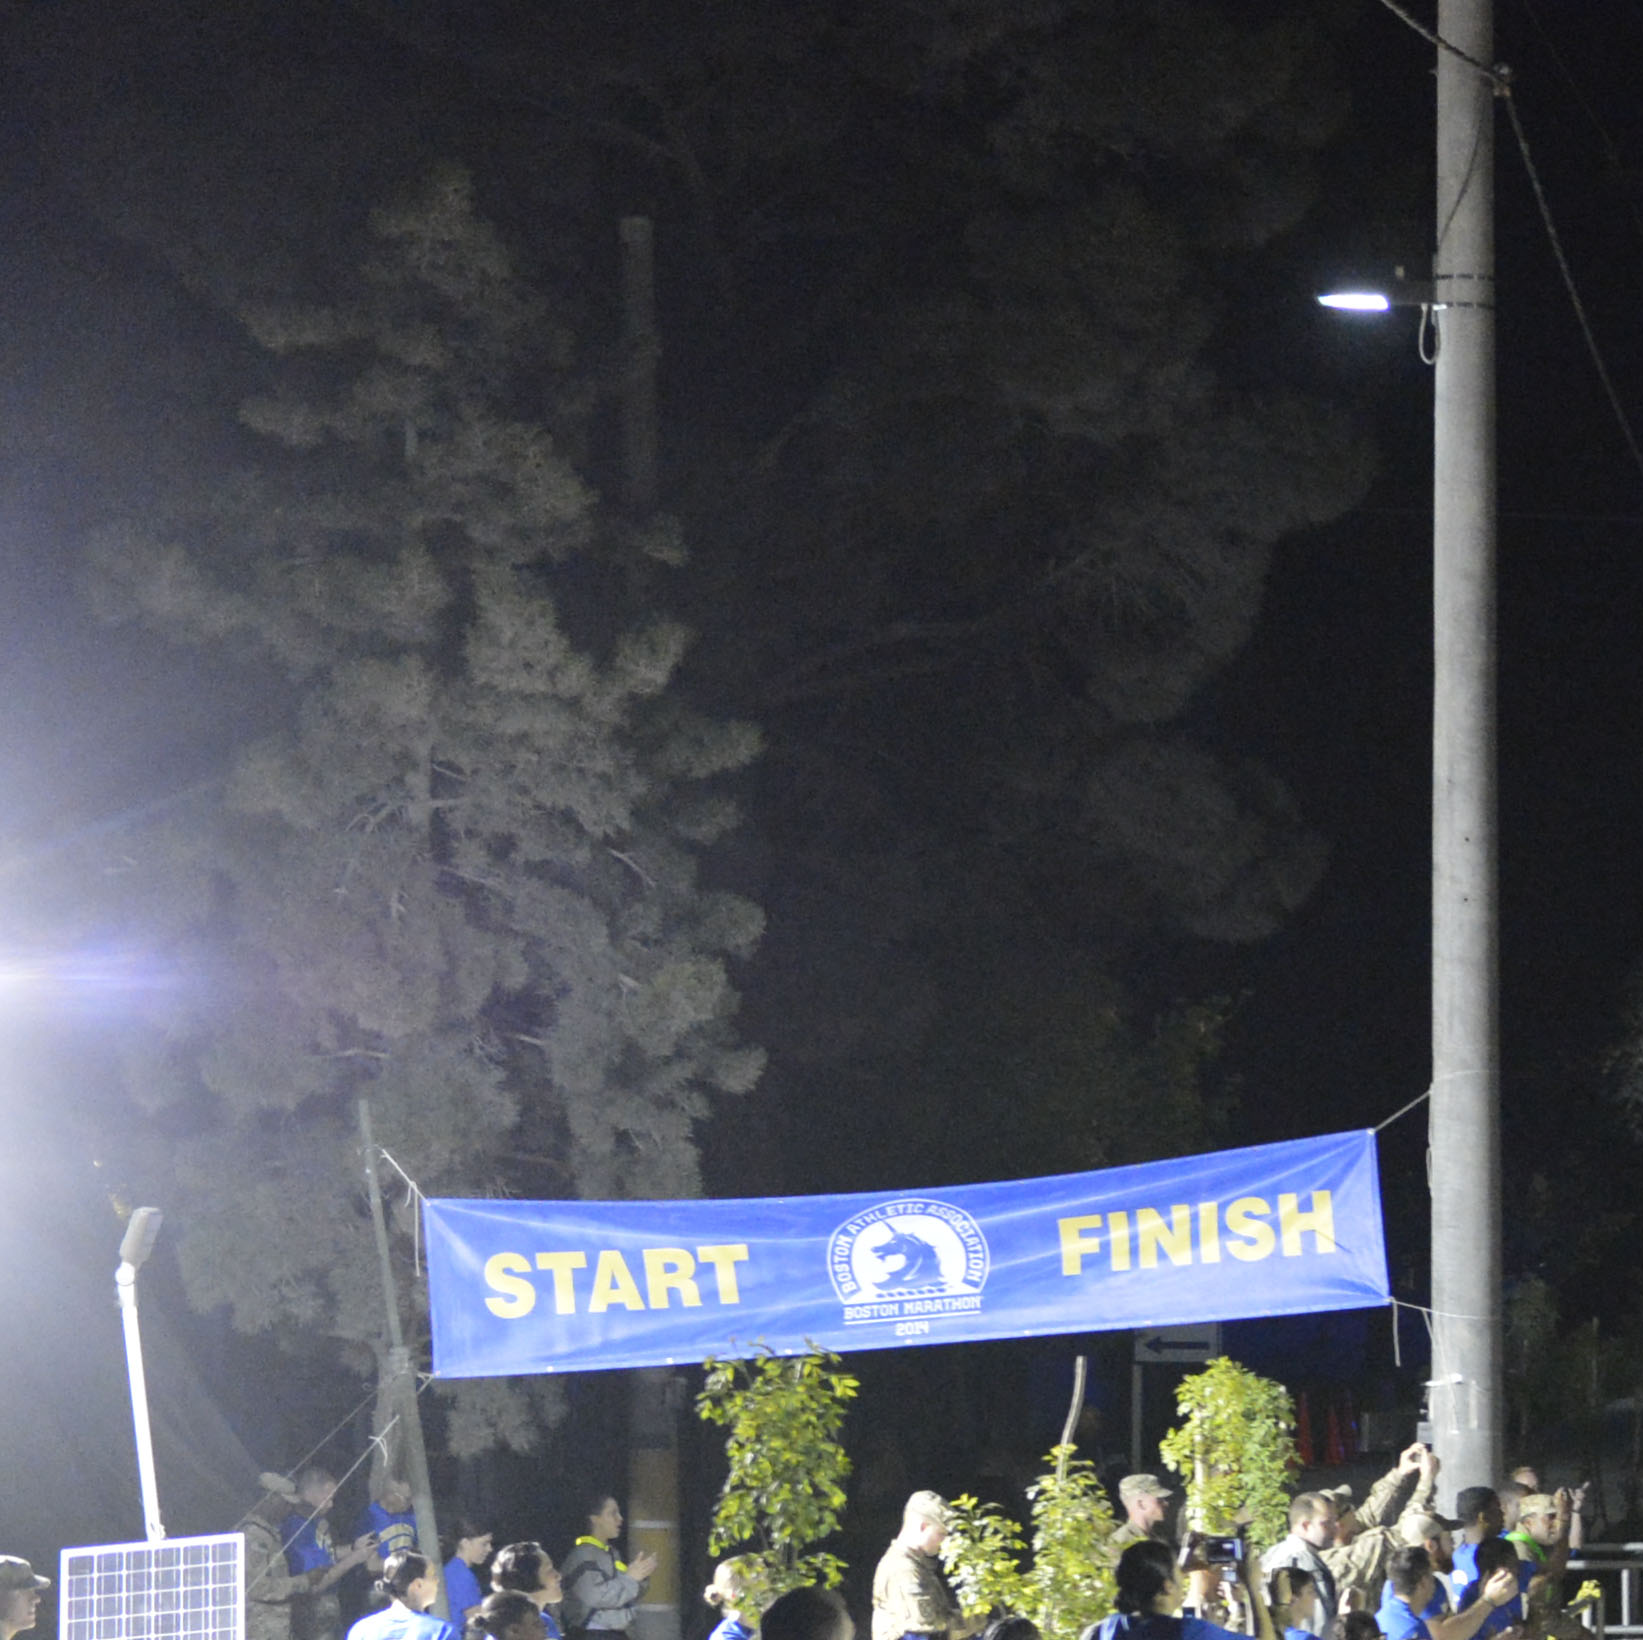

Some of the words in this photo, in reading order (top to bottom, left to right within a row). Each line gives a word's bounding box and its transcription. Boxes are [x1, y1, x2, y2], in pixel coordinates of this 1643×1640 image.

[834, 1234, 858, 1294] BOSTON
[846, 1203, 925, 1235] ATHLETIC
[925, 1204, 985, 1283] ASSOCIATION
[1058, 1190, 1337, 1276] FINISH
[485, 1243, 748, 1320] START
[843, 1303, 900, 1320] BOSTON
[903, 1296, 983, 1315] MARATHON
[895, 1321, 930, 1336] 2014
